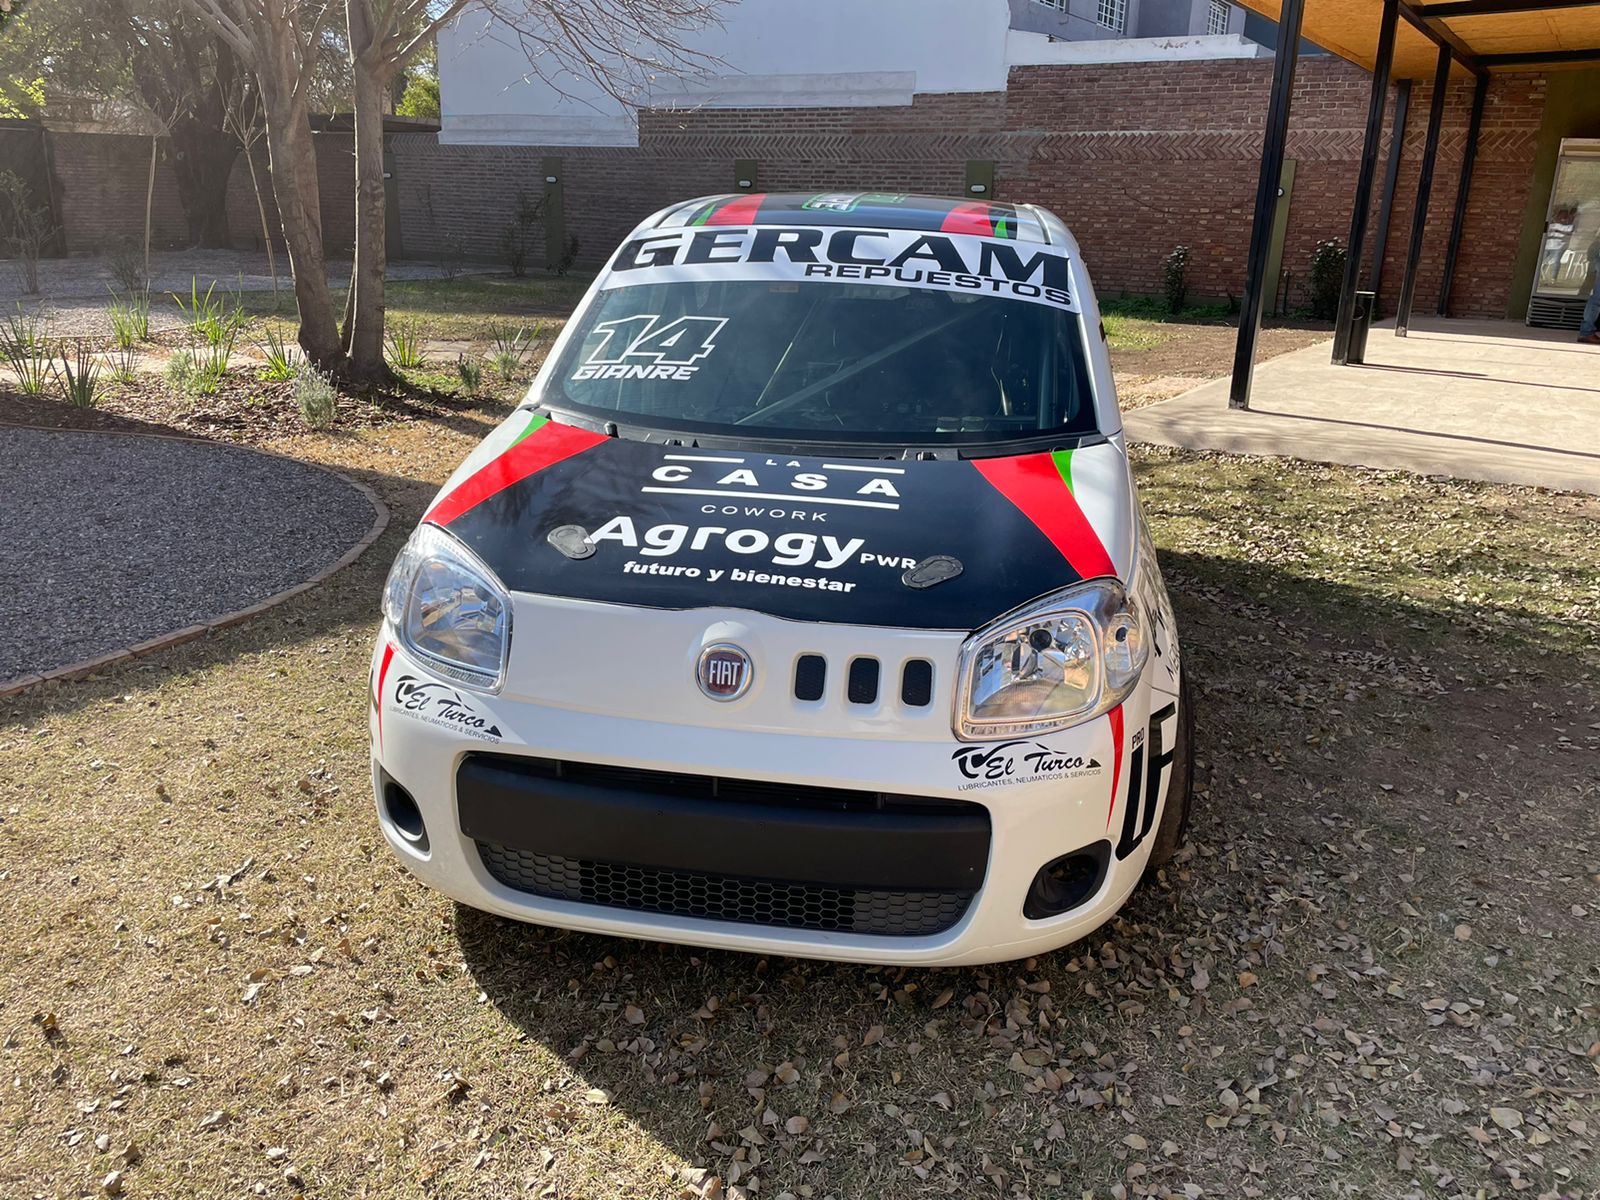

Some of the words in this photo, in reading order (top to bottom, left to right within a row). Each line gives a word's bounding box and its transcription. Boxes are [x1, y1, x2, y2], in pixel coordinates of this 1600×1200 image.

[611, 228, 1071, 293] GERCAM
[804, 263, 1072, 306] REPUESTOS
[584, 314, 730, 366] 14
[571, 364, 700, 381] GIANRE
[765, 458, 802, 468] LA
[651, 464, 901, 498] CASA
[700, 503, 828, 523] COWORK
[586, 515, 866, 570] Agrogy
[859, 553, 917, 570] PWR
[622, 560, 701, 580] futuro
[707, 568, 725, 583] y
[729, 567, 857, 594] bienestar
[708, 659, 741, 686] FIAT
[437, 698, 486, 729] Turco
[1131, 726, 1145, 749] PRO
[1015, 771, 1063, 783] NEUMATICOS
[1024, 751, 1085, 774] Turco
